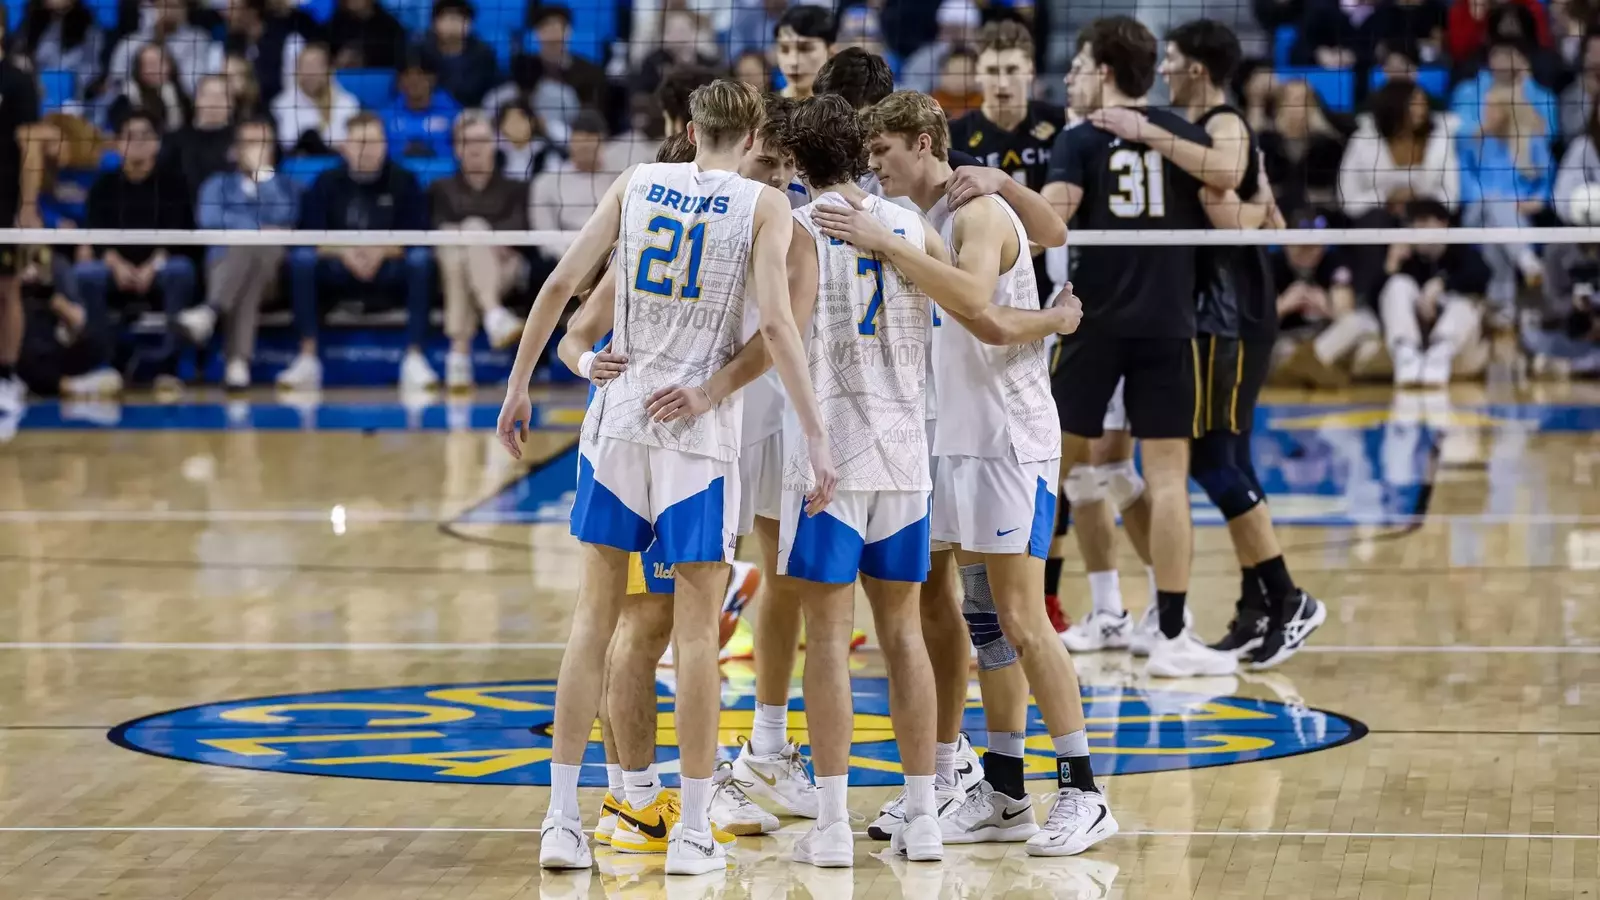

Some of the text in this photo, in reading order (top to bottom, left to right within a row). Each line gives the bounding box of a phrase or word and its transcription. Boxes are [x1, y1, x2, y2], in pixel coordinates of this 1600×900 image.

[976, 148, 1052, 168] EACH
[1108, 150, 1165, 218] 31
[633, 212, 709, 303] 21
[632, 298, 727, 333] ESTWOO
[856, 254, 884, 338] 7
